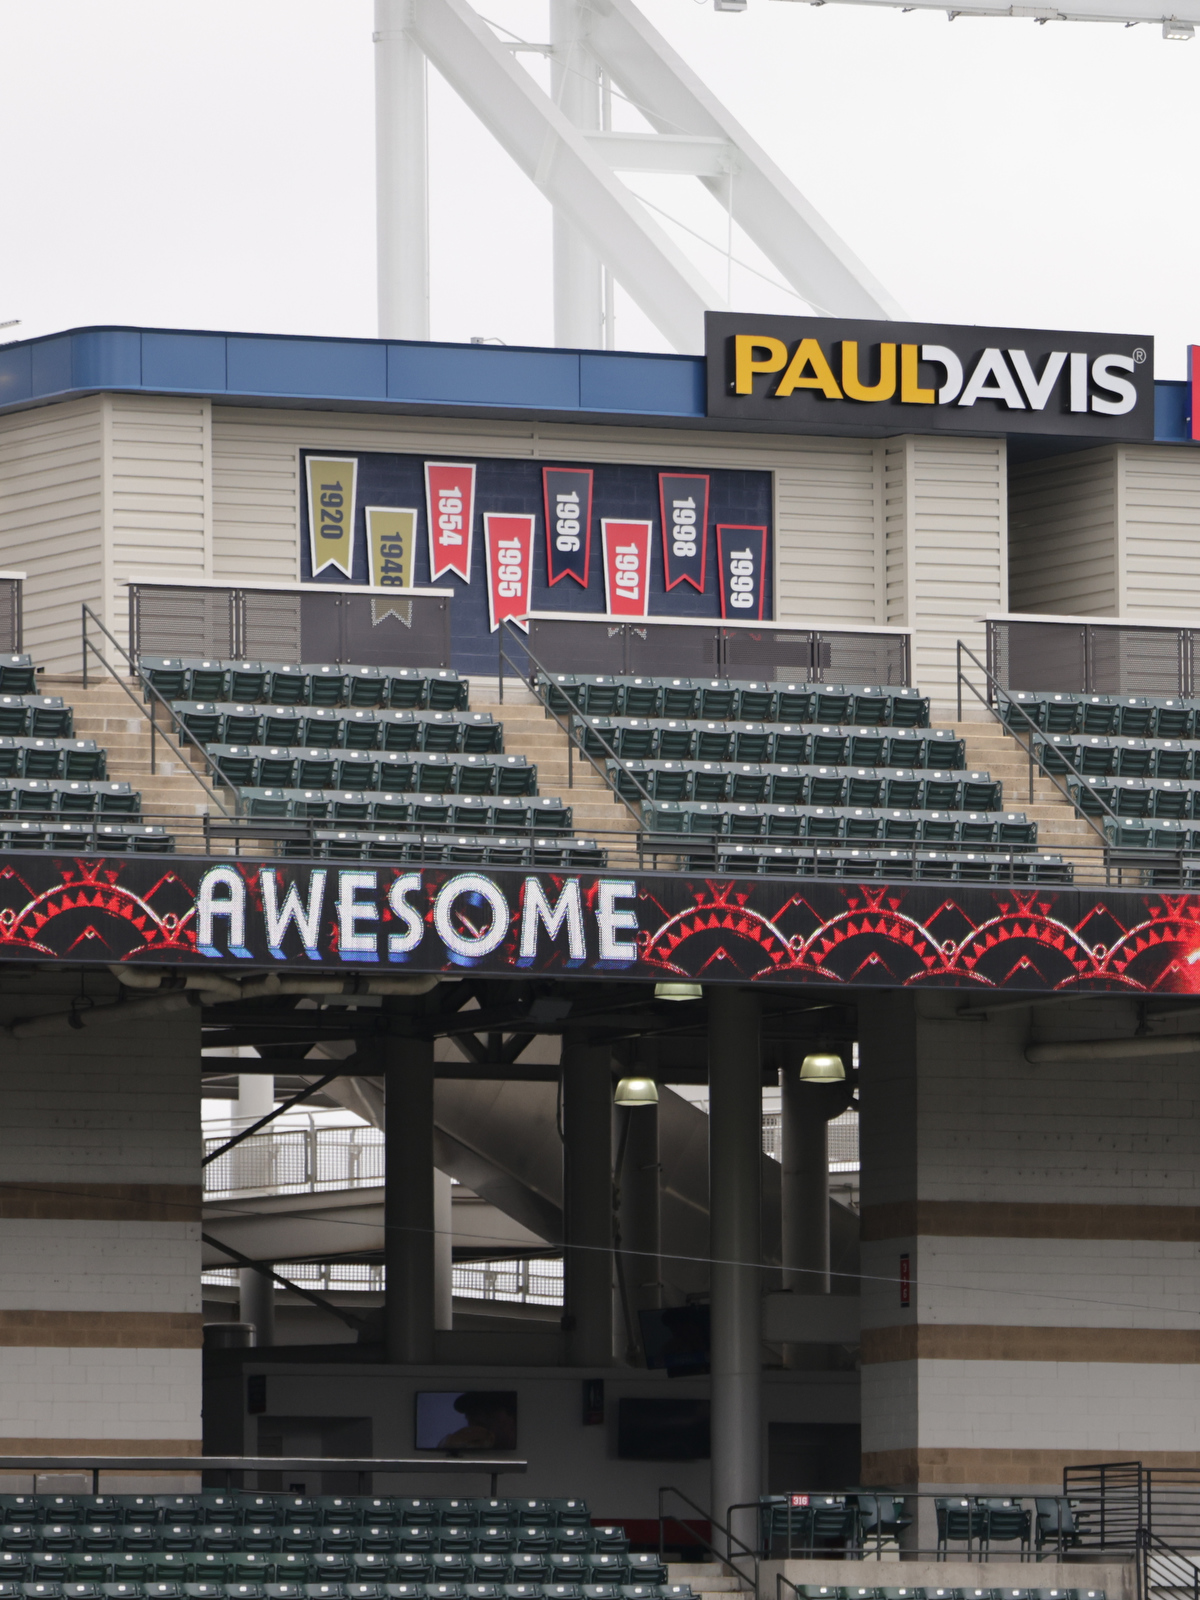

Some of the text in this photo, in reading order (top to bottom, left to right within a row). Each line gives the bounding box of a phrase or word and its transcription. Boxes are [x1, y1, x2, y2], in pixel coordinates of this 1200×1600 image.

[321, 480, 343, 540] 1920
[438, 486, 463, 547] 1954
[556, 491, 580, 552] 1996
[673, 496, 697, 557] 1998
[380, 531, 403, 587] 1948
[497, 537, 522, 598] 1995
[615, 542, 639, 600] 1997
[730, 547, 754, 608] 1999
[198, 864, 639, 964] AWESOME
[793, 1496, 808, 1506] 316
